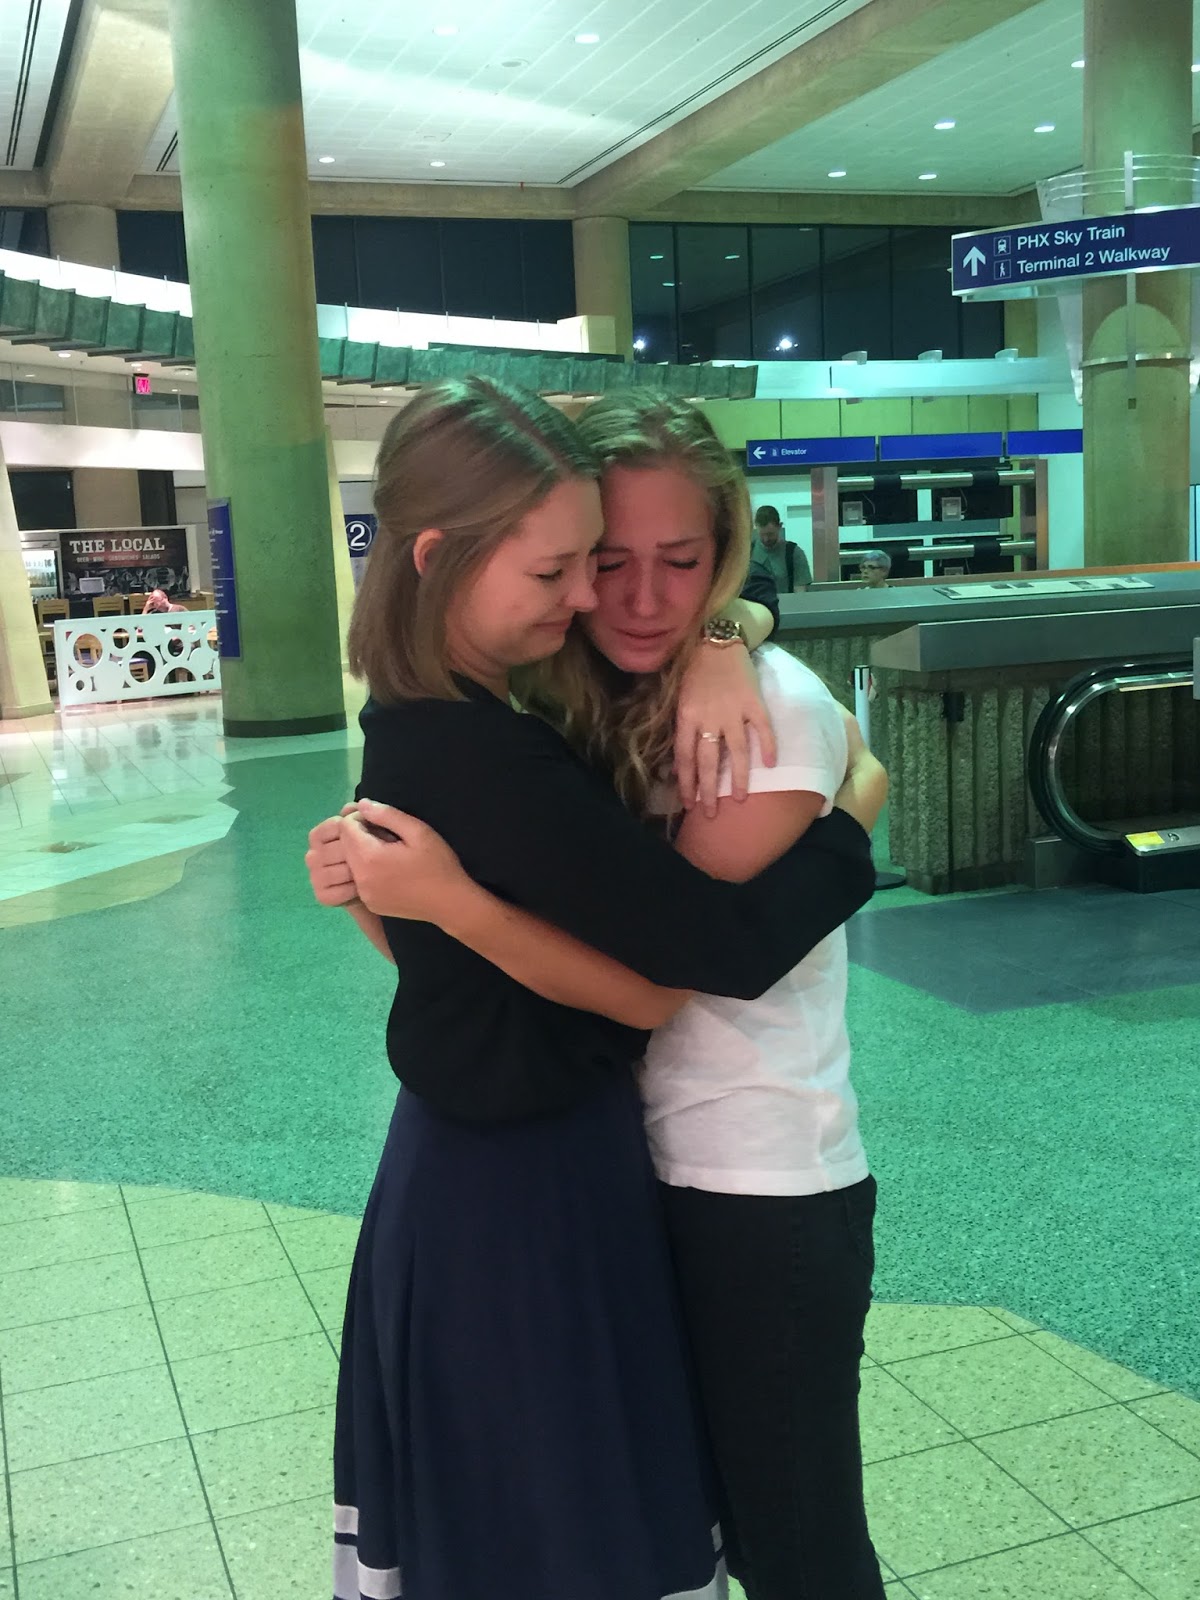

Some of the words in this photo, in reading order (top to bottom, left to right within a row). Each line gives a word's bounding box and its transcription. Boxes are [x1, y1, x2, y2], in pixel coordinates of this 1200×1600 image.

[1017, 233, 1050, 250] PHX
[1054, 229, 1082, 246] Sky
[1087, 225, 1125, 240] Train
[1017, 254, 1079, 273] Terminal
[1085, 252, 1094, 265] 2
[1099, 247, 1170, 263] Walkway
[781, 448, 806, 456] Elevator
[69, 540, 105, 554] THE
[110, 538, 165, 552] LOCAL
[350, 523, 366, 547] 2
